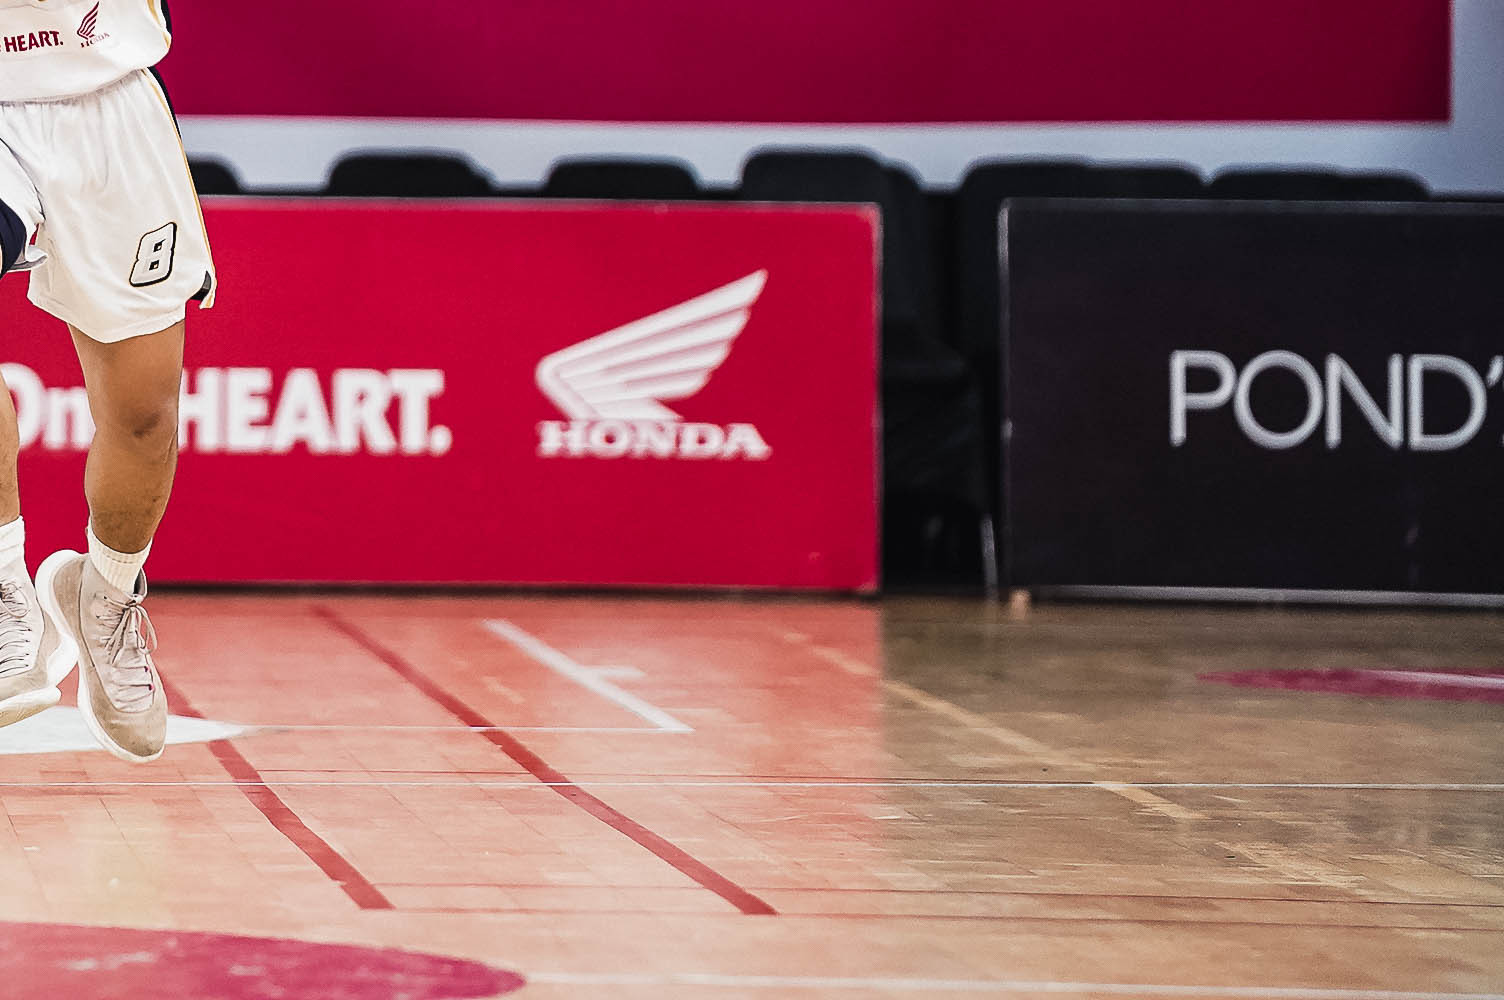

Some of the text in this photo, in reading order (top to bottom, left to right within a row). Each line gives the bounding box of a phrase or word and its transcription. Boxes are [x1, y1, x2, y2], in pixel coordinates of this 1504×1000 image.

[4, 30, 64, 52] HEART.
[129, 221, 177, 287] 8
[0, 362, 95, 450] On
[1169, 349, 1504, 450] POND'
[536, 419, 772, 459] HONDA
